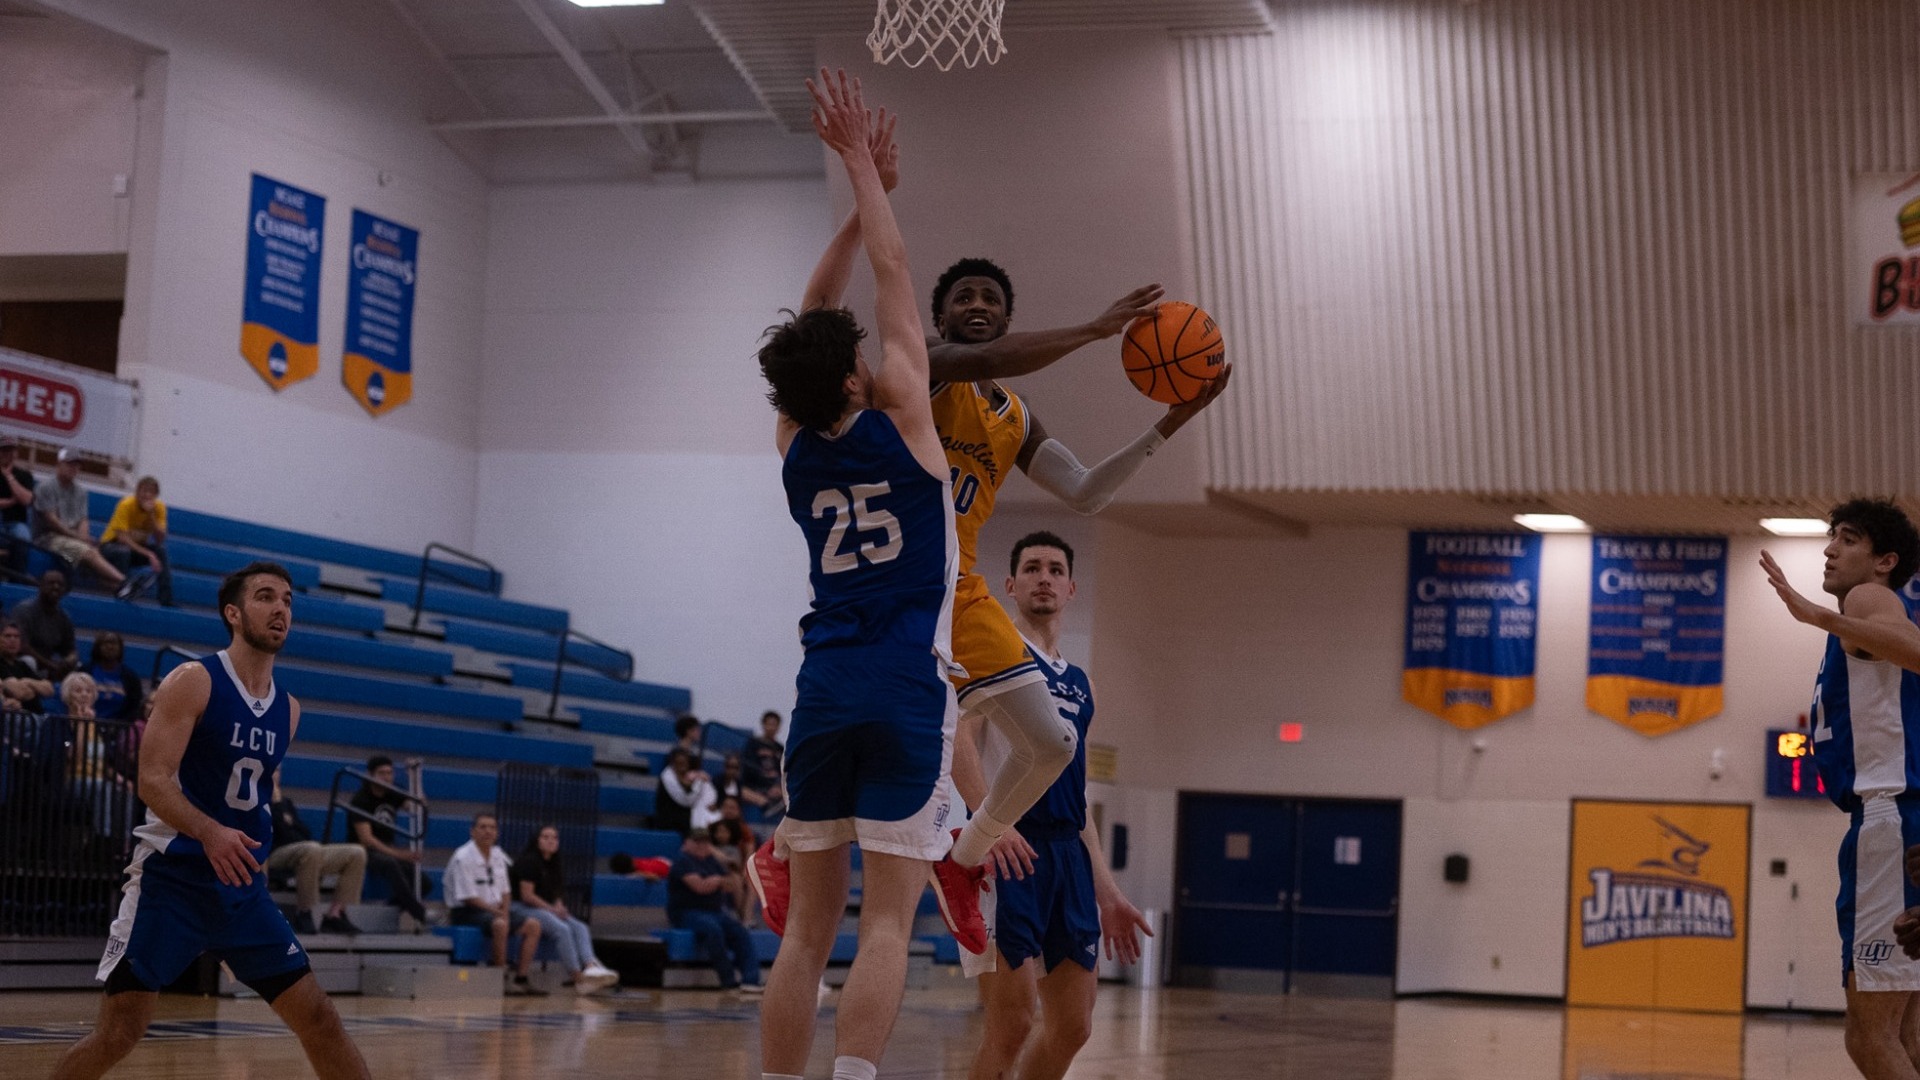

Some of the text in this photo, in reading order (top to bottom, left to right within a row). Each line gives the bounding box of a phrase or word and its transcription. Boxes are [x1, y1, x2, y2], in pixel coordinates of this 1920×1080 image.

[811, 479, 904, 575] 25
[1426, 536, 1526, 557] FOOTBALL
[1598, 538, 1723, 561] TRACK & FIELD
[1416, 577, 1531, 605] CHAMPIONS
[1600, 568, 1718, 596] CHAMPIONS
[230, 721, 277, 756] LCU
[224, 756, 265, 812] 0
[1583, 869, 1731, 923] JAVELINA
[1584, 920, 1632, 946] MEN'S
